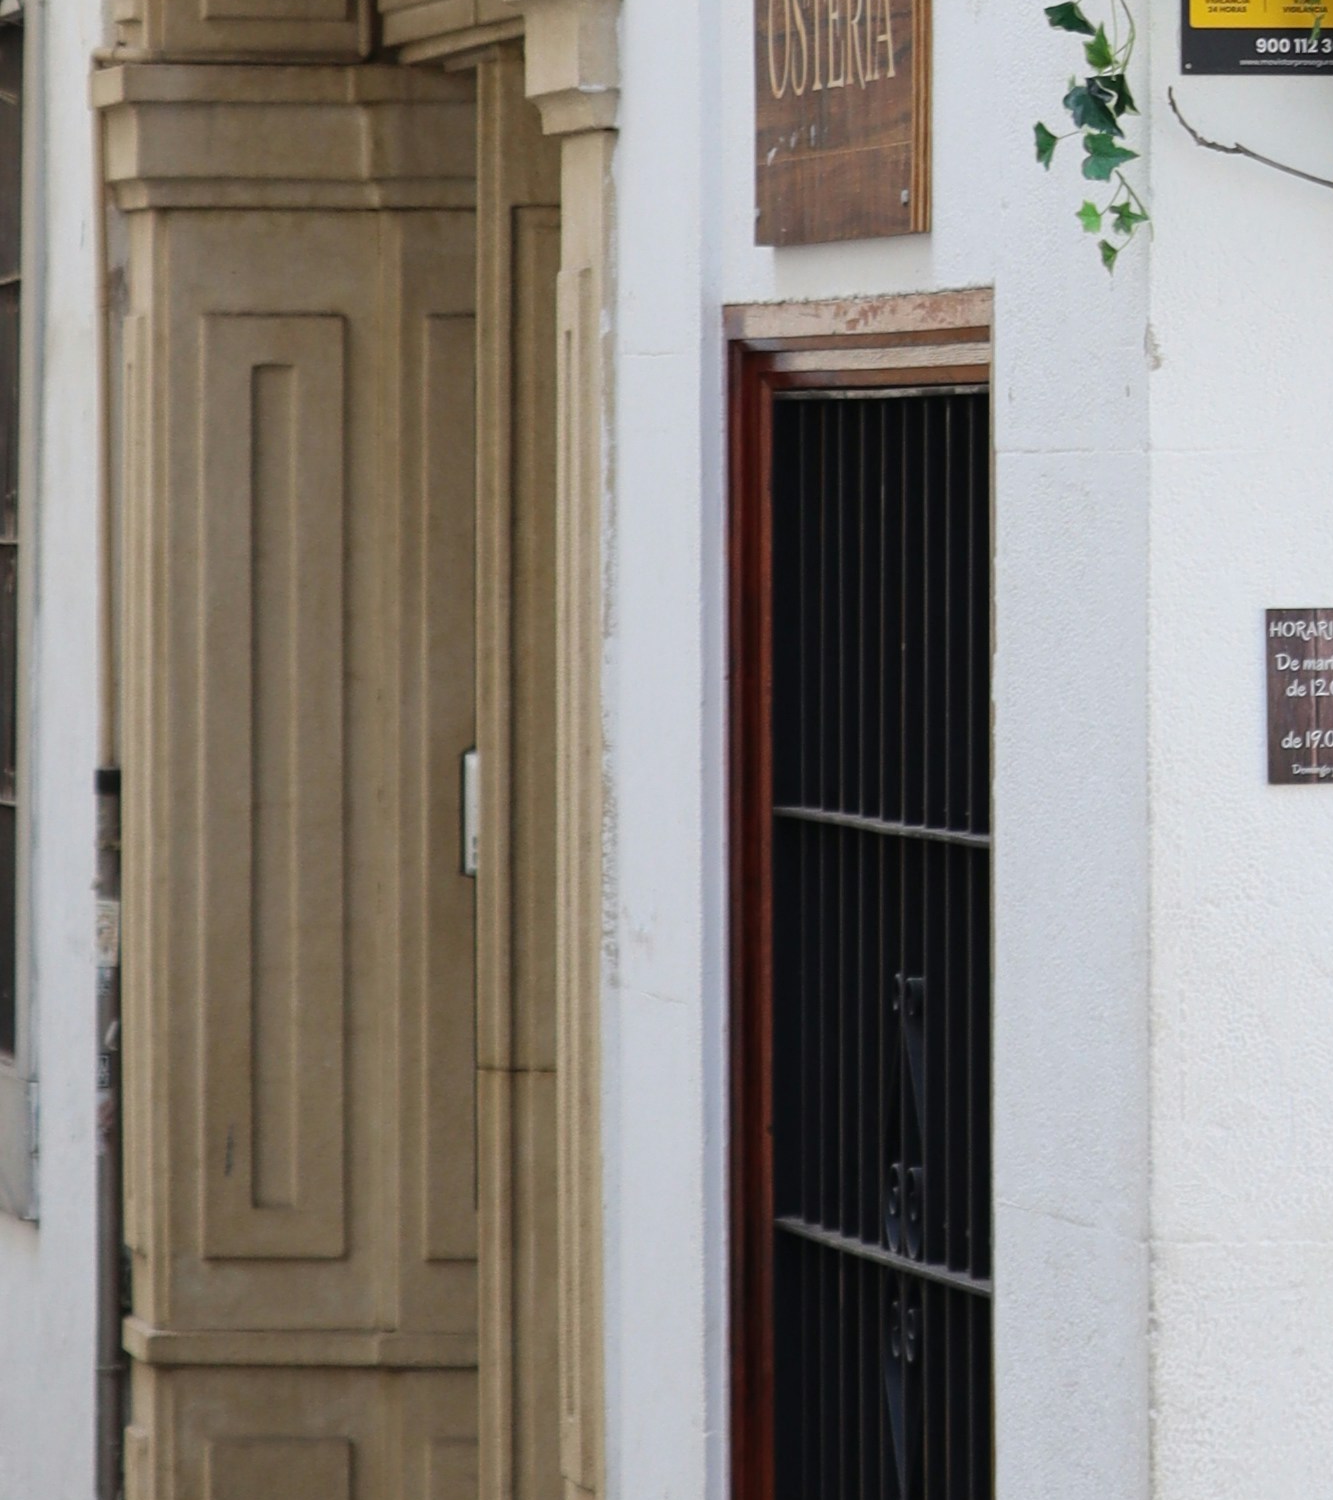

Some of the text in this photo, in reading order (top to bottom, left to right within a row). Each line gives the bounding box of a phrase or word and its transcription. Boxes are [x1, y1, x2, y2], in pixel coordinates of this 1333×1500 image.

[1255, 37, 1291, 54] 900
[1293, 37, 1319, 54] 112
[1275, 653, 1300, 671] De
[1286, 678, 1307, 697] de
[1281, 730, 1303, 749] de
